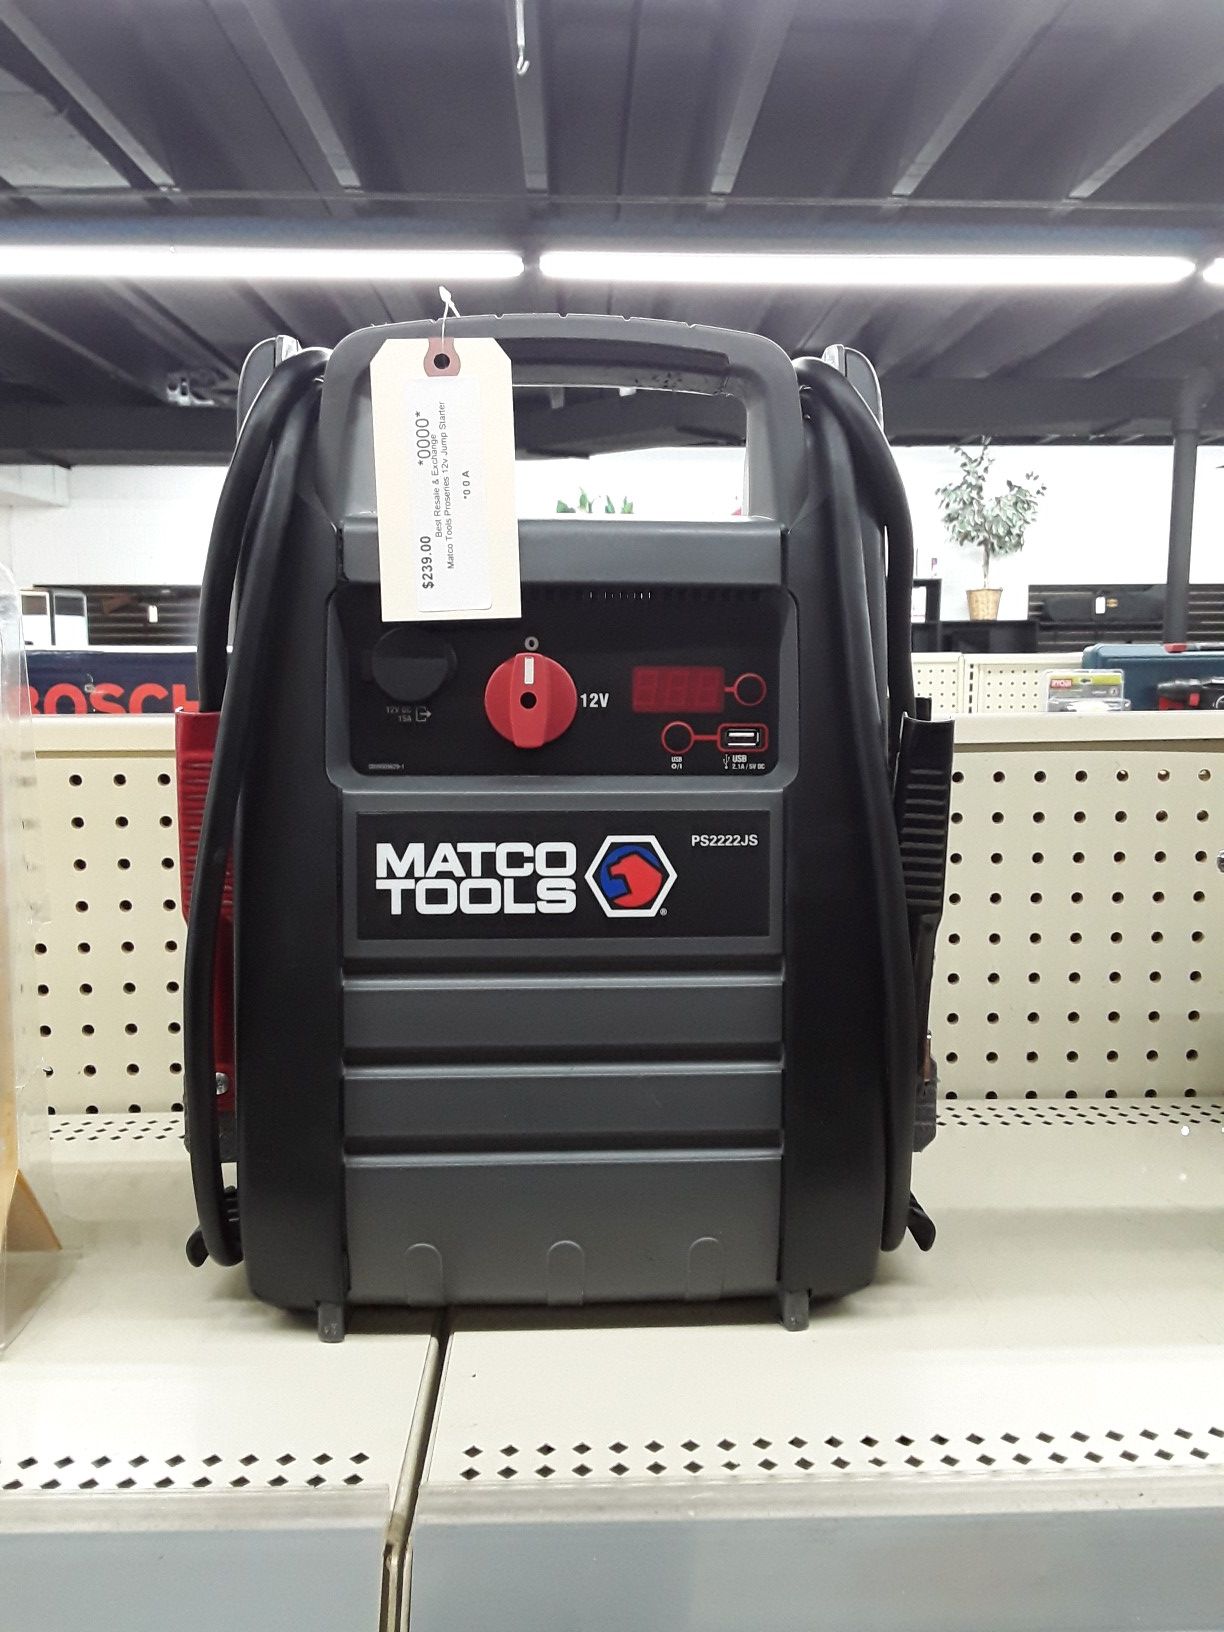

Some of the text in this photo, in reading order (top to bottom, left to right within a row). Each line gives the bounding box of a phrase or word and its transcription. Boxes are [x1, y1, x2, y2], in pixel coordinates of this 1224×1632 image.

[431, 434, 439, 476] Exchange
[438, 401, 455, 569] Matco Tools Proseries 12v Jump Starter
[433, 487, 441, 517] Resale
[435, 519, 443, 538] Best
[419, 535, 435, 589] $239.00
[580, 693, 609, 708] 12V
[732, 755, 747, 763] USB
[691, 834, 759, 847] PS2222JS
[376, 842, 577, 878] MATCO
[376, 878, 577, 915] TOOLS
